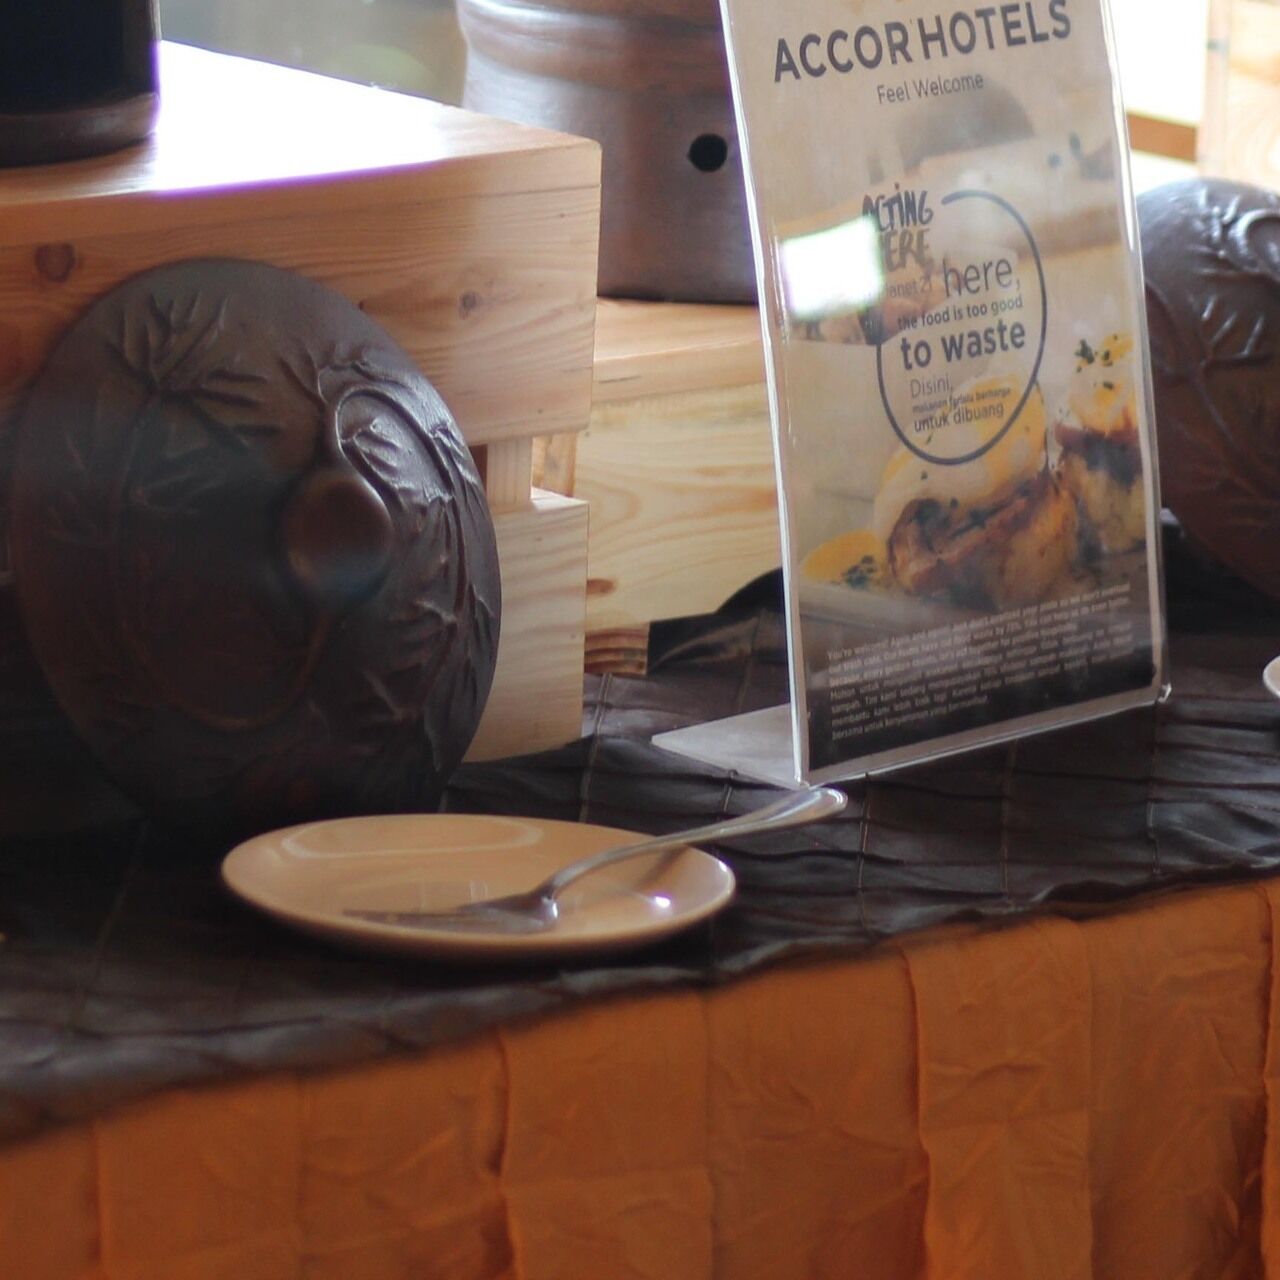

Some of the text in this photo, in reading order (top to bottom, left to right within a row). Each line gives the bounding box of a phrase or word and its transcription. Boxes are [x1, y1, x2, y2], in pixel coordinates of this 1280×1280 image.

[877, 72, 984, 105] Feel Welcome
[879, 228, 931, 272] ERE
[942, 257, 1021, 299] here,
[897, 296, 1023, 330] the food is too good
[901, 319, 1026, 371] to waste
[910, 373, 954, 399] Disini,
[914, 403, 1004, 433] untuk dibuang
